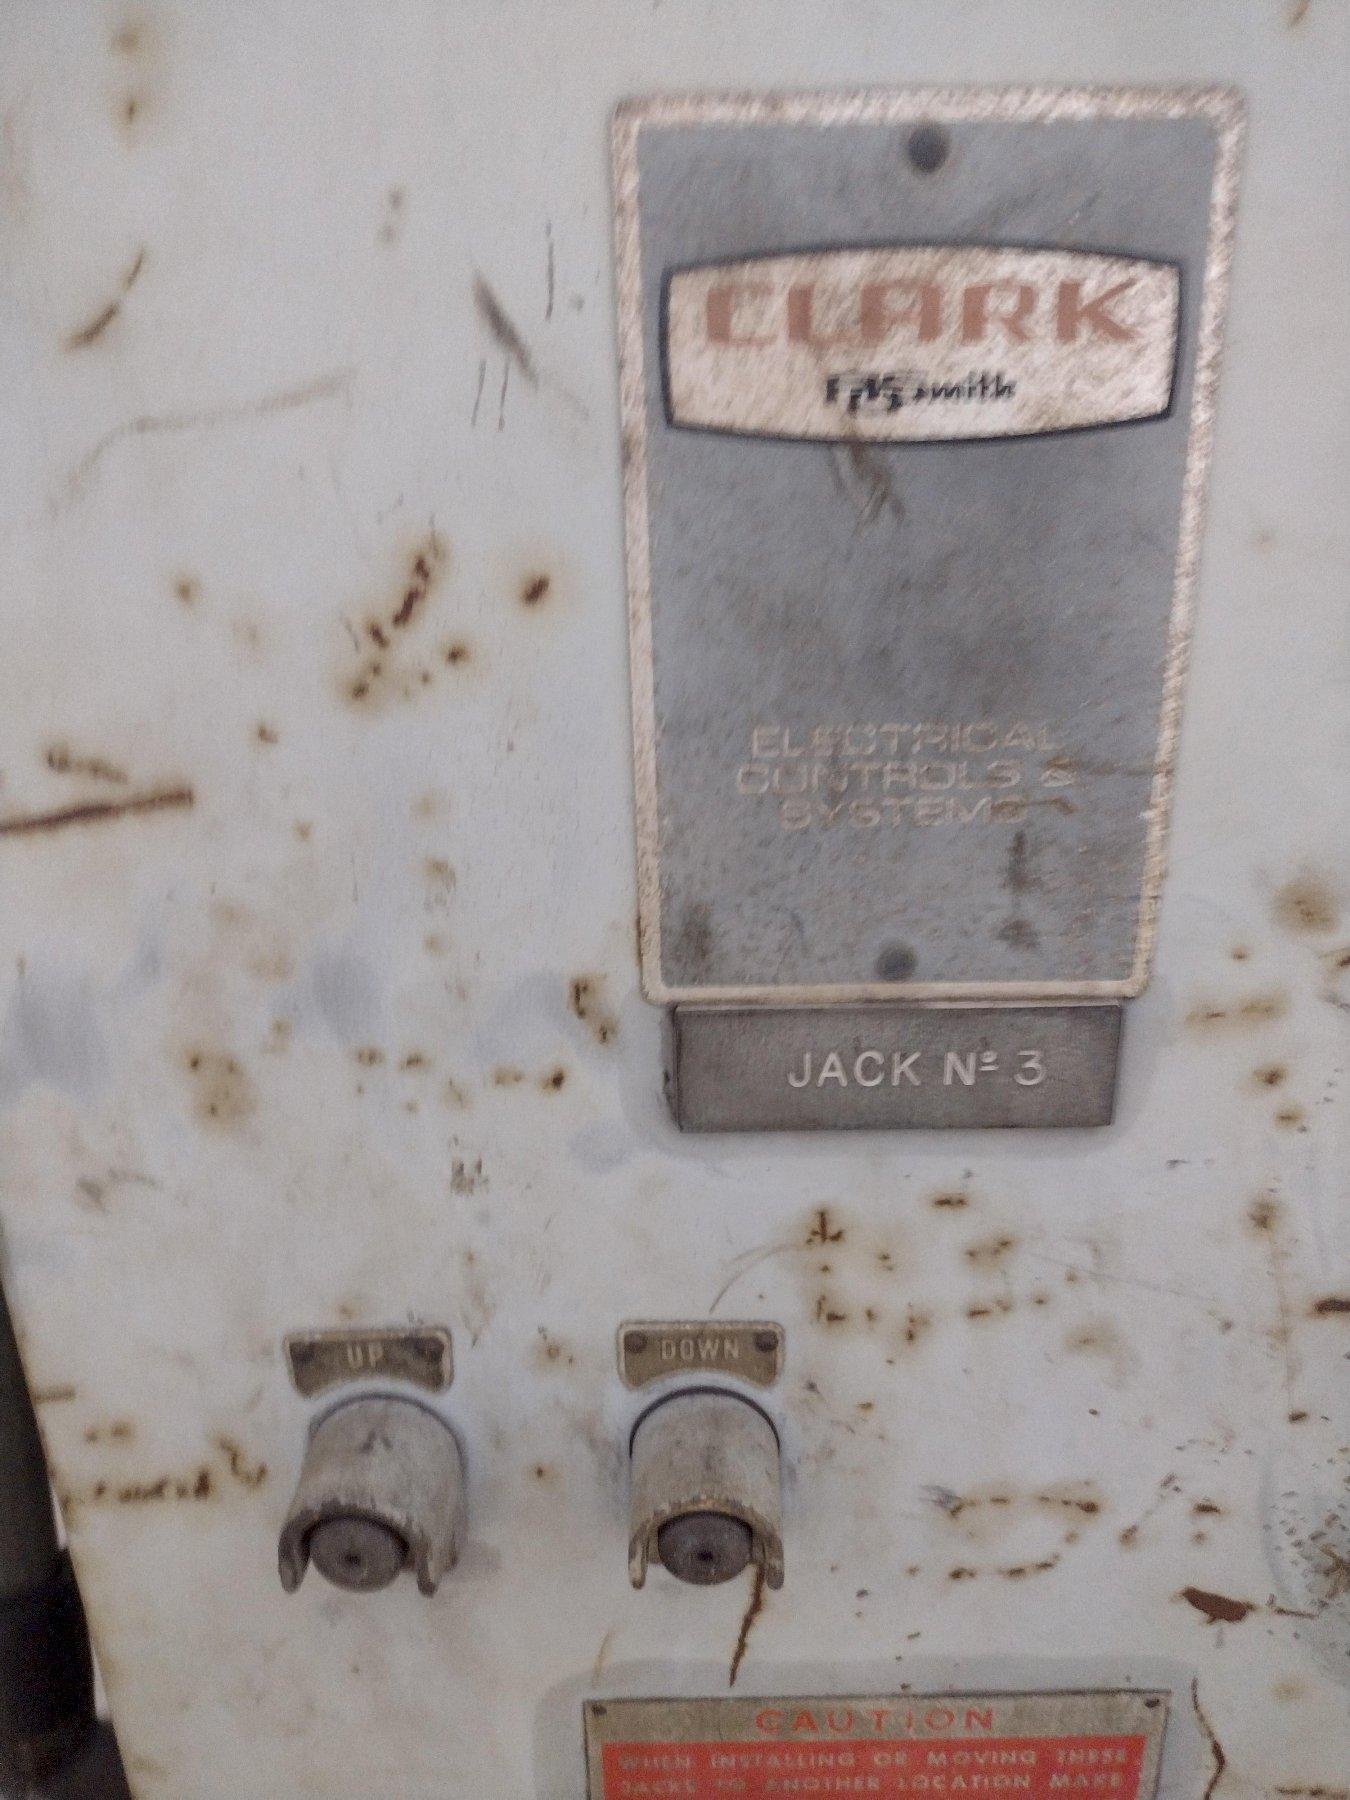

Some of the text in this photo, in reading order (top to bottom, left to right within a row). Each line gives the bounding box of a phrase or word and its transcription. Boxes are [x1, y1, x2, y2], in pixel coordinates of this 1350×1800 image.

[705, 276, 1141, 348] CLARK
[752, 720, 1065, 758] ELECTRICAL
[737, 760, 1022, 795] CONTROLS
[780, 796, 1028, 832] SYSTEMS
[787, 1051, 922, 1088] JACK
[1013, 1050, 1047, 1086] 3
[345, 1342, 385, 1369] UP
[659, 1337, 742, 1361] DOWN
[755, 1707, 993, 1734] CAUTION
[618, 1748, 1127, 1770] WHEN INSTALLING OR MOVING THESE
[766, 1775, 881, 1792] ANOTHER
[897, 1773, 1031, 1791] LOCATION
[1049, 1772, 1123, 1790] MAKE
